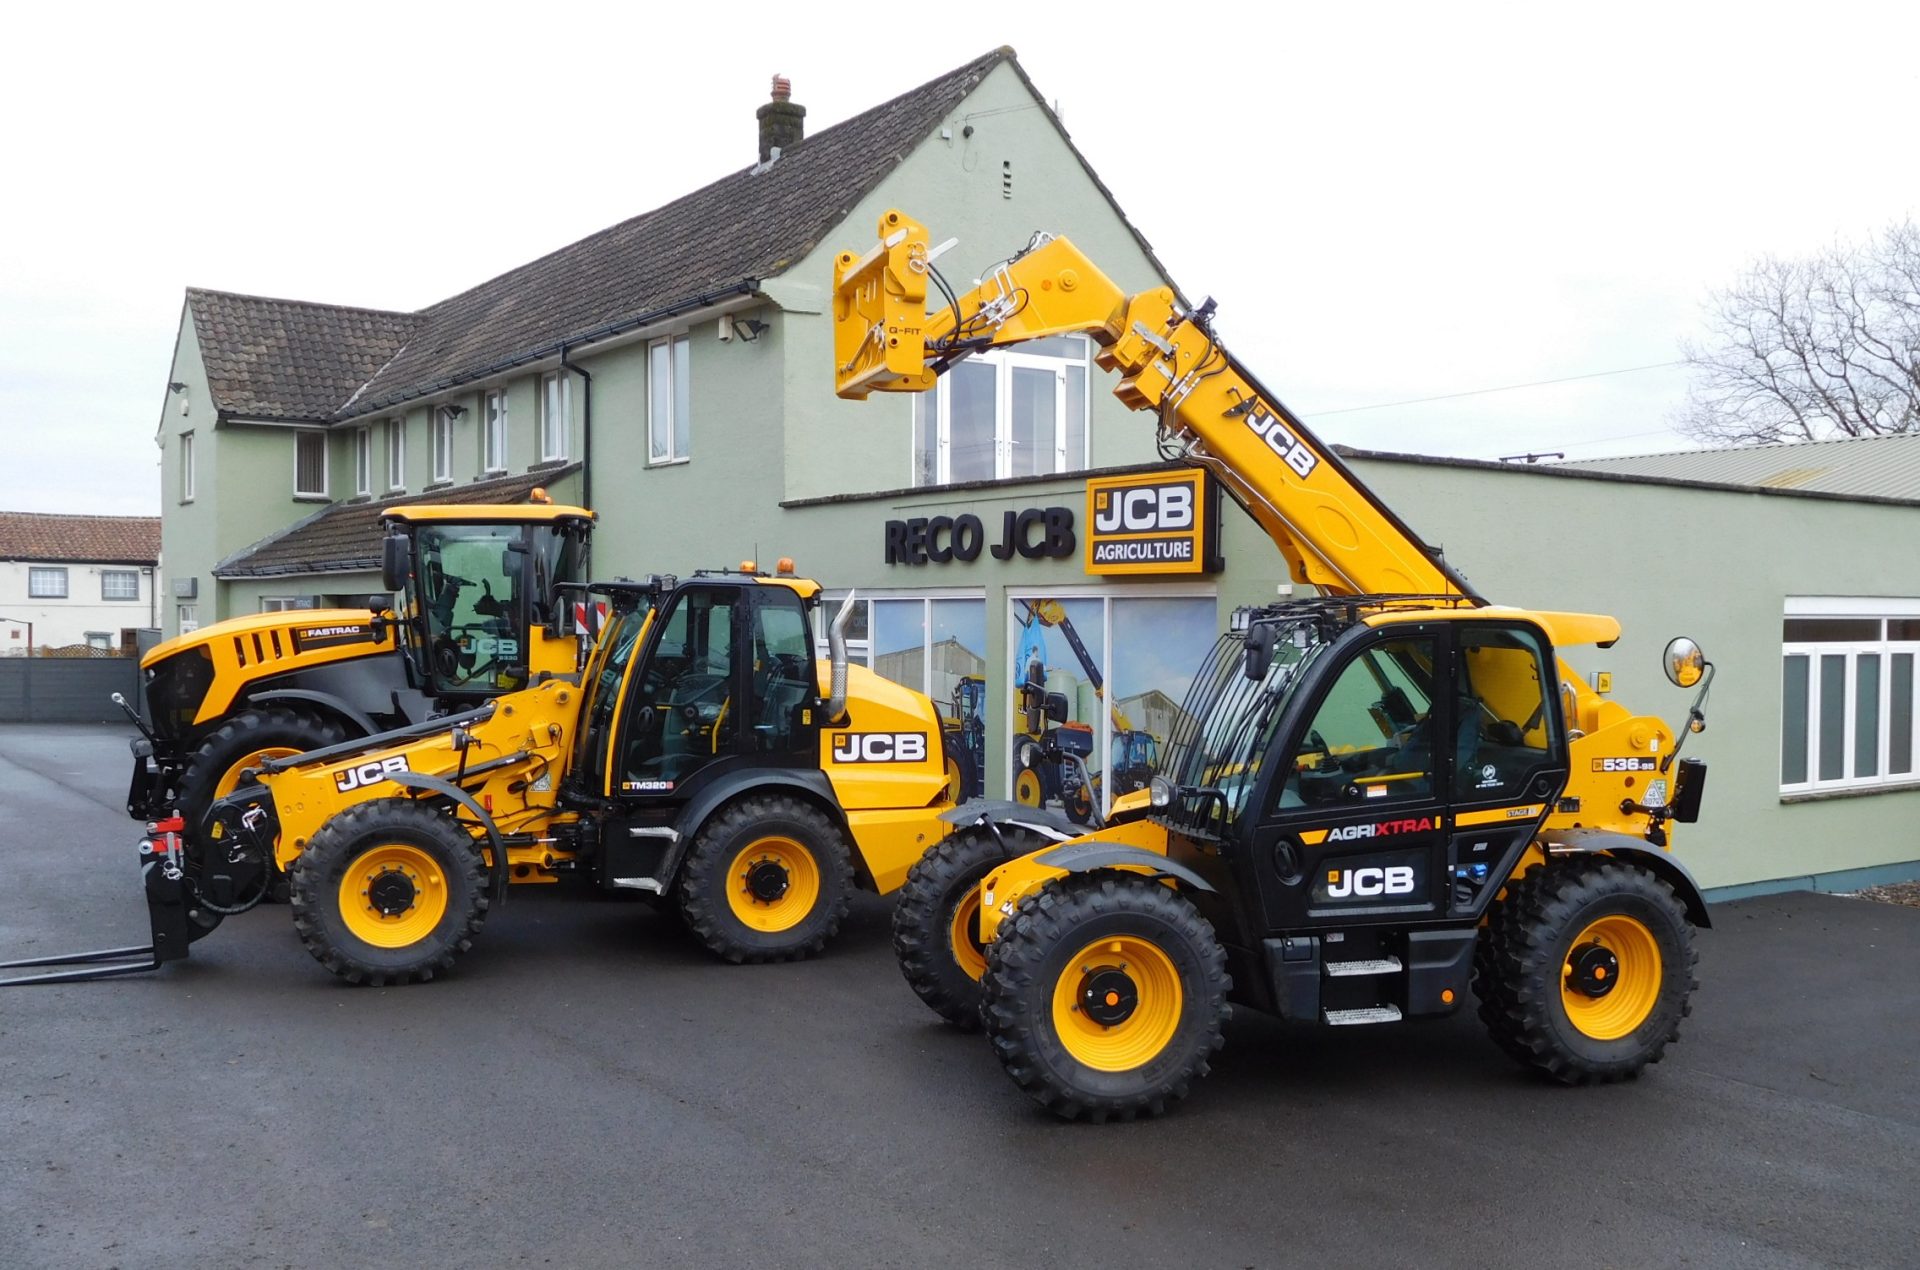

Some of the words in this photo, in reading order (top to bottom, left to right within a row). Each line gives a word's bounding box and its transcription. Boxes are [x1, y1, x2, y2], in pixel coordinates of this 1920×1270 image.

[889, 327, 921, 335] Q-FIT
[1247, 413, 1316, 477] JCB
[1096, 486, 1192, 531] JCB
[884, 514, 984, 566] RECO
[990, 507, 1076, 560] JCB
[1096, 541, 1191, 561] AGRICULTURE
[308, 626, 360, 637] FASTRAC
[460, 638, 519, 654] JCB
[834, 733, 926, 762] JCB
[337, 756, 409, 792] JCB
[1507, 808, 1527, 817] STAGE
[1327, 817, 1432, 842] AGRIXTRA
[1327, 866, 1415, 897] JCB
